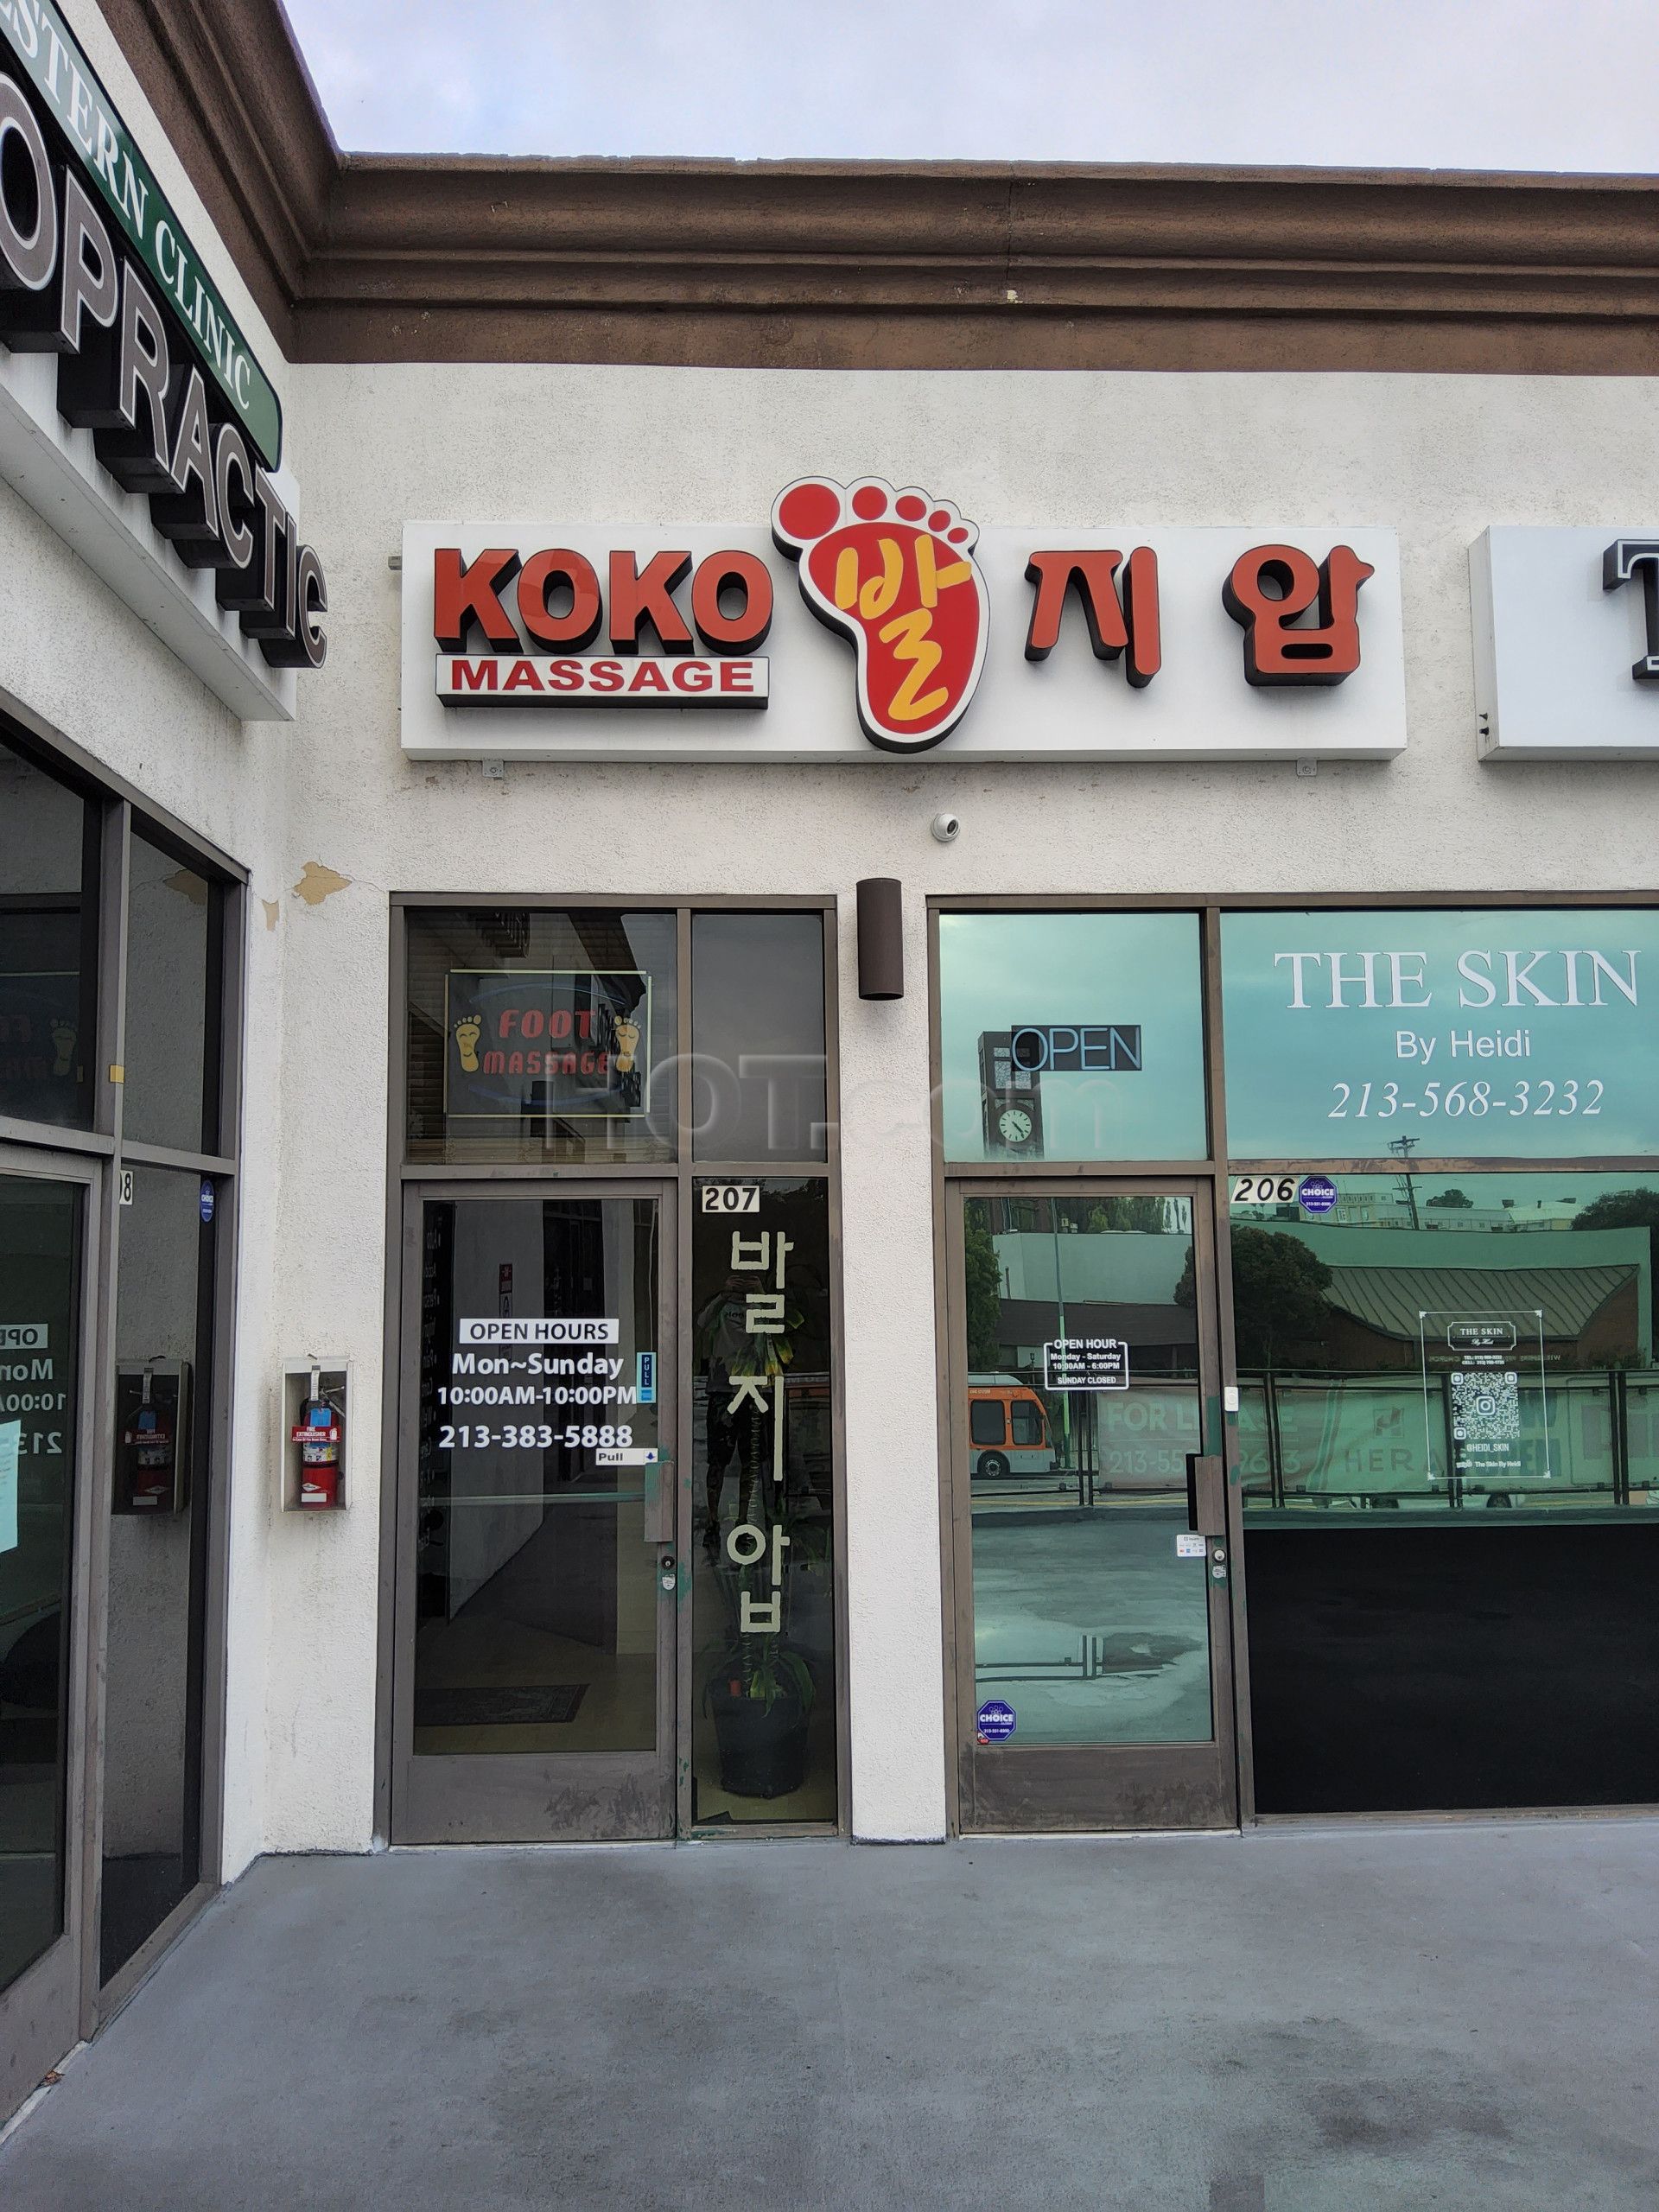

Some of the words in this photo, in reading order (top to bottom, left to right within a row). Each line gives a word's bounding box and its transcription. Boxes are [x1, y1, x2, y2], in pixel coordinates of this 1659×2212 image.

[155, 219, 251, 410] CLINIC
[435, 548, 773, 644] KOKO
[452, 659, 754, 693] MASSAGE
[1274, 951, 1433, 1008] THE
[1456, 950, 1642, 1007] SKIN
[499, 1009, 598, 1039] FOOT
[1012, 1026, 1141, 1071] OPEN
[1395, 1030, 1436, 1065] By
[1450, 1029, 1531, 1058] Heidi
[483, 1050, 610, 1075] MASSAGE
[1328, 1078, 1605, 1118] 213-568-3232
[705, 1186, 757, 1211] 207
[1235, 1178, 1295, 1202] 206
[1301, 1188, 1335, 1197] CHOICE
[469, 1323, 529, 1341] OPEN
[535, 1323, 609, 1341] HOURS
[1053, 1338, 1084, 1350] OPEN
[1086, 1338, 1117, 1349] HOUR
[452, 1352, 624, 1380] Mon~Sunday
[1050, 1352, 1081, 1362] Monday
[1086, 1352, 1121, 1361] Saturday
[437, 1386, 638, 1405] 10:00AM-10:00PM
[1105, 1400, 1166, 1432] FOR
[439, 1425, 633, 1449] 213-383-5888
[598, 1452, 624, 1462] Pull
[979, 1713, 1014, 1722] CHOICE
